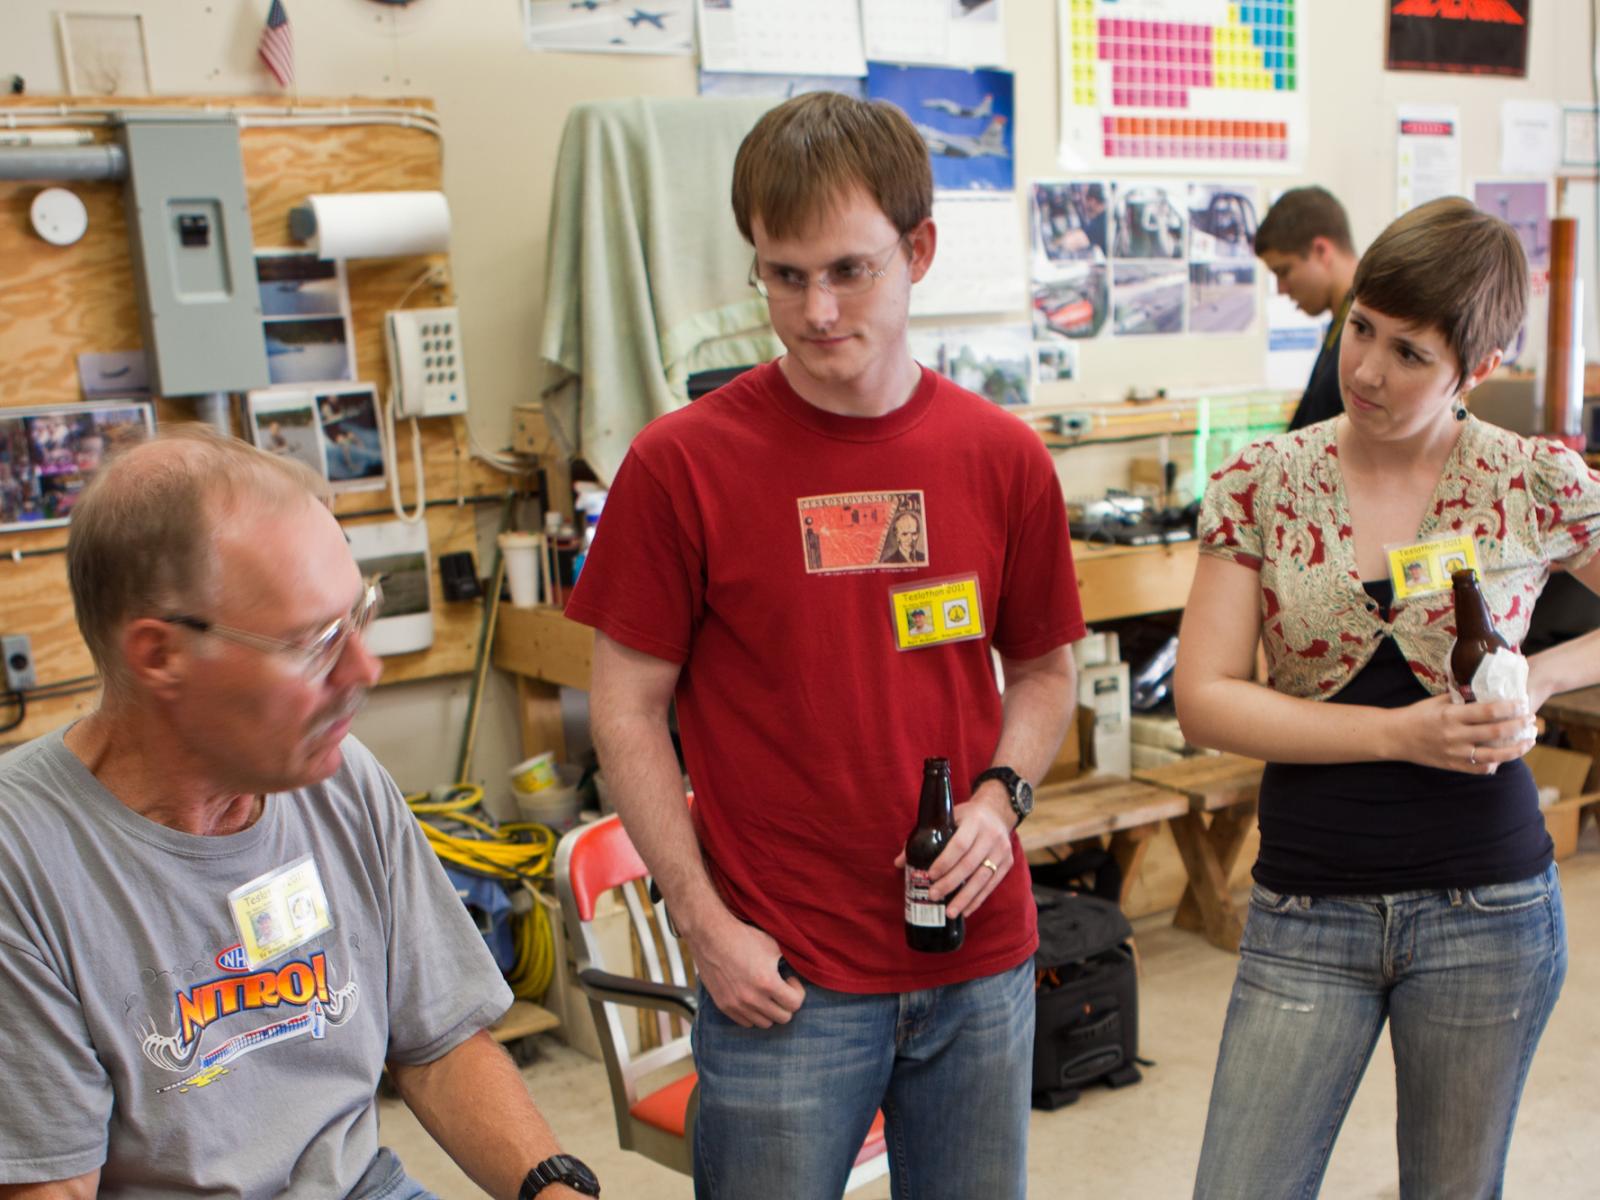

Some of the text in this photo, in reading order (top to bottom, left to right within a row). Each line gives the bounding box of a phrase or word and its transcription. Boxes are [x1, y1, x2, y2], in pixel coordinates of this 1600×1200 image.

[902, 583, 965, 601] Teslathon 2011
[177, 952, 330, 1047] NITRO!
